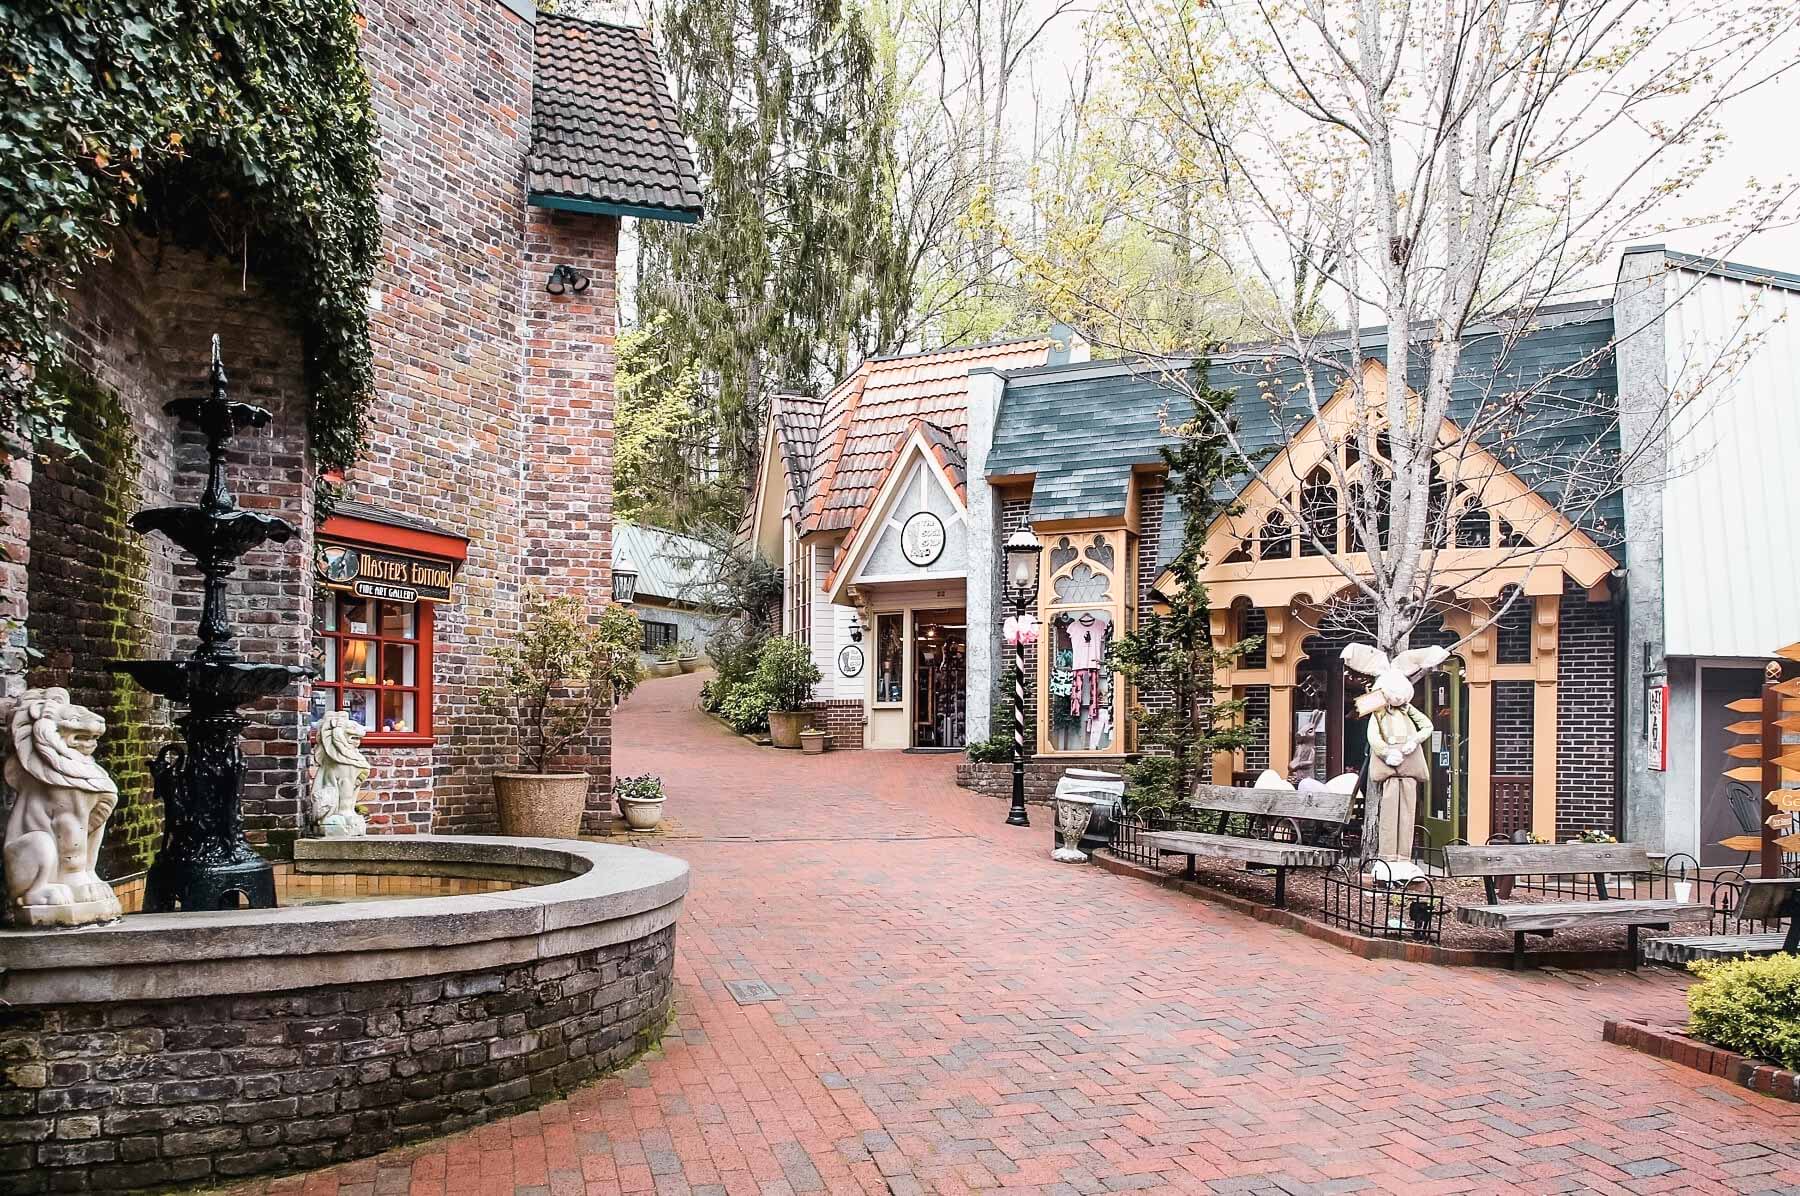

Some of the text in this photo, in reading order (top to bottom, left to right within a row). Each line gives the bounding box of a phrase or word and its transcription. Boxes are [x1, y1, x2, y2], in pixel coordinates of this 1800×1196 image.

[360, 554, 451, 588] MASTER'S EDITIONS
[359, 583, 415, 601] FINE ART GALLERY
